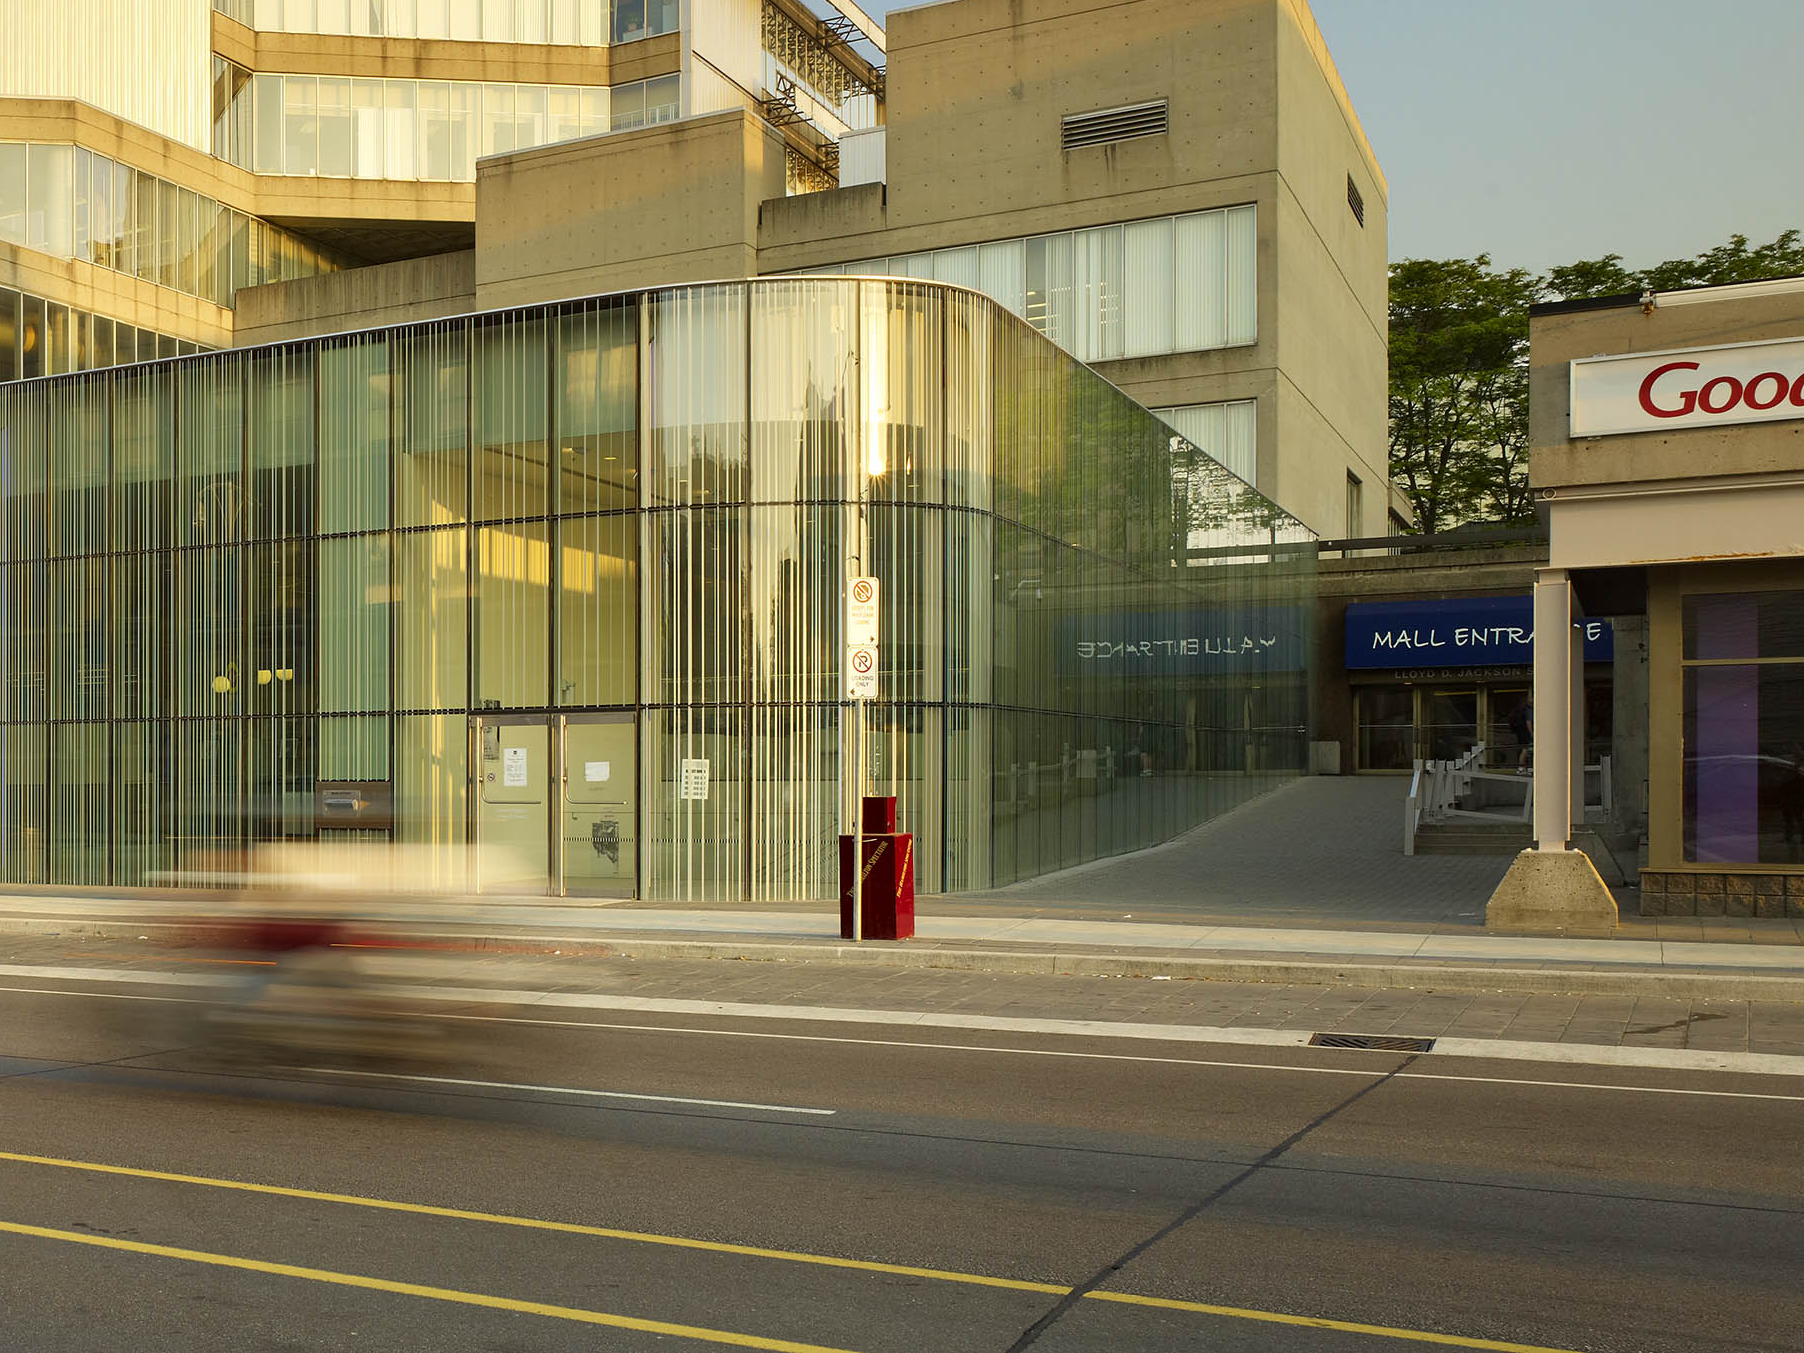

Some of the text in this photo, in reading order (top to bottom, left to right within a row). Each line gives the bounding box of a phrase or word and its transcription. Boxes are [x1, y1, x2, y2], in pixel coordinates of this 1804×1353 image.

[1372, 622, 1602, 649] MALL ENTRE
[1395, 669, 1436, 679] LLOYD
[1457, 667, 1521, 678] JACKSON
